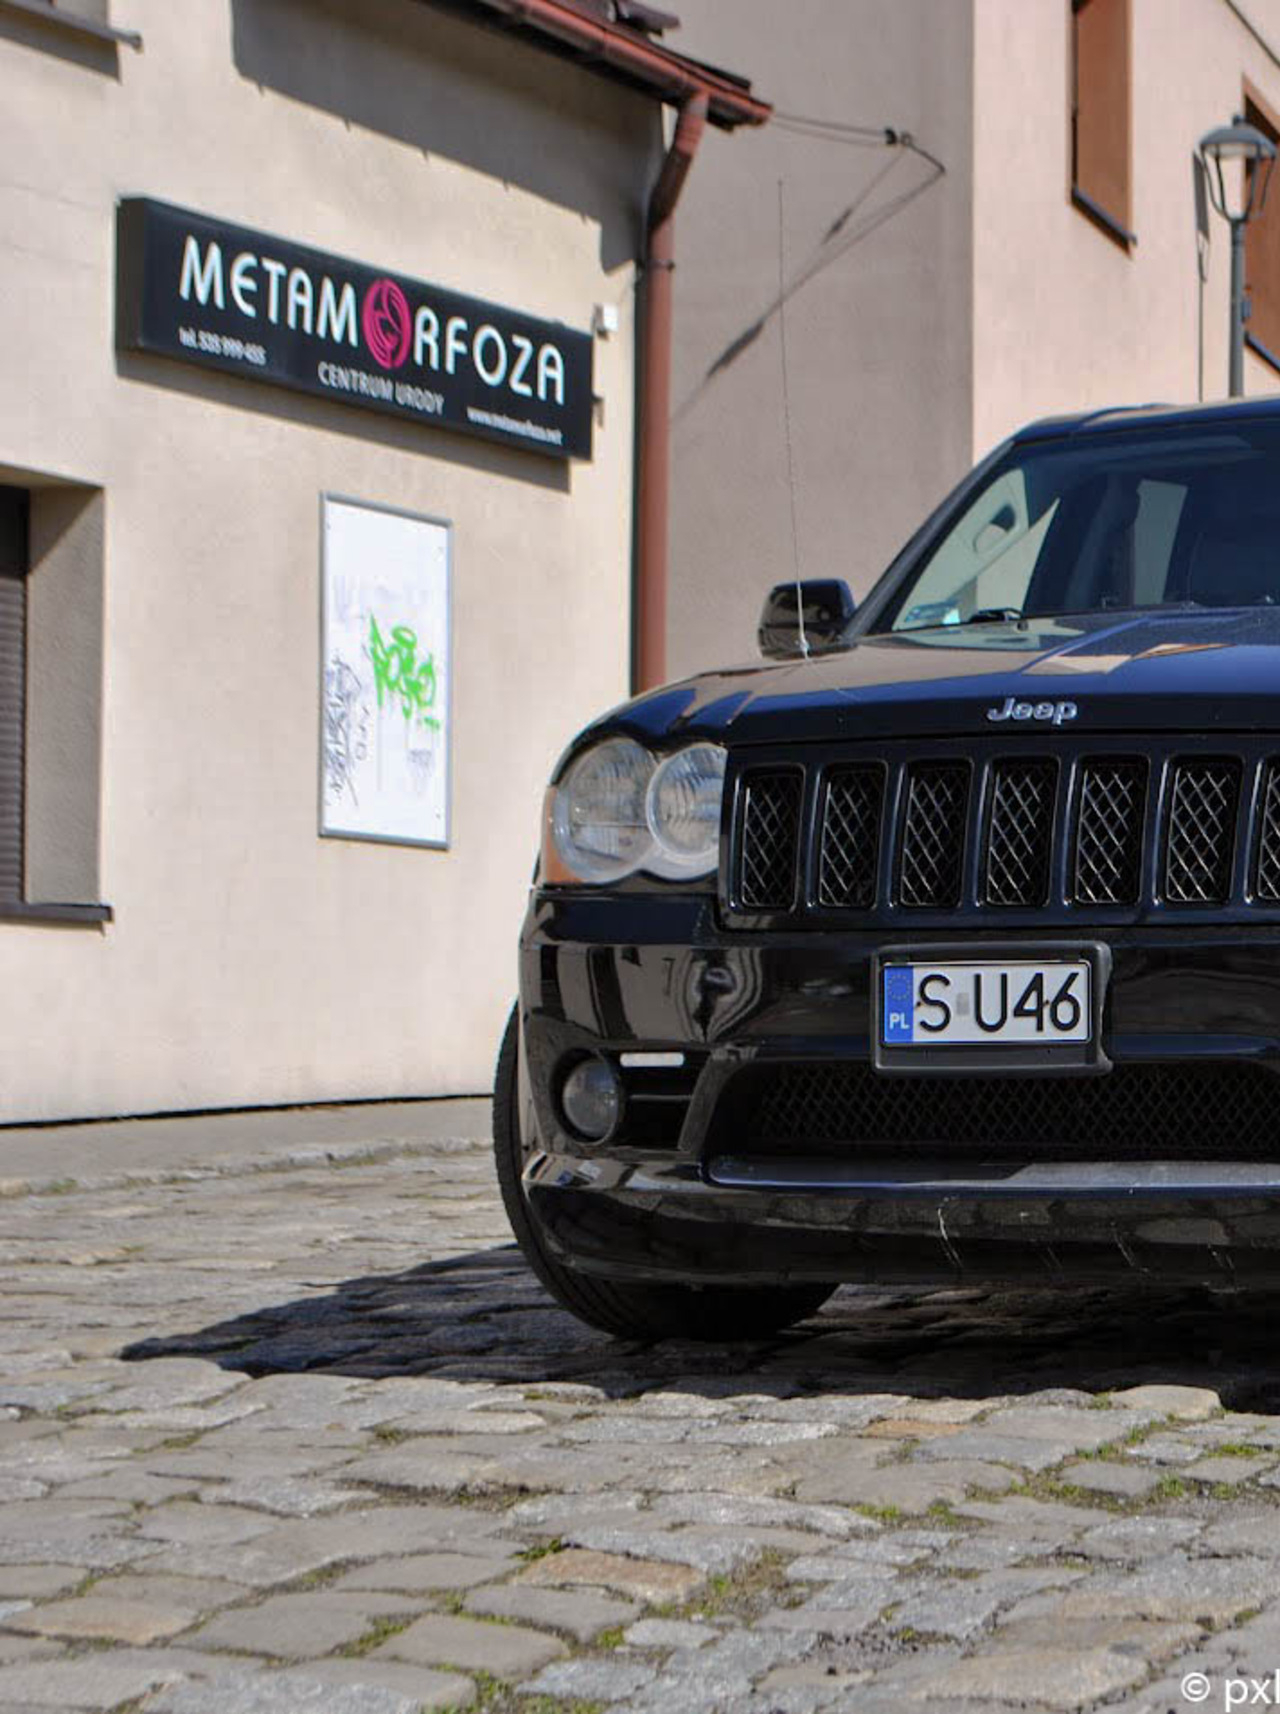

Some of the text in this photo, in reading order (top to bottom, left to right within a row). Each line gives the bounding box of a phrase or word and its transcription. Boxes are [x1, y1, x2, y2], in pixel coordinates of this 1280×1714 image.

[318, 361, 444, 415] CENTRUM URODY
[987, 698, 1077, 725] Jeep
[889, 1013, 909, 1030] PL
[919, 972, 1081, 1032] S U46
